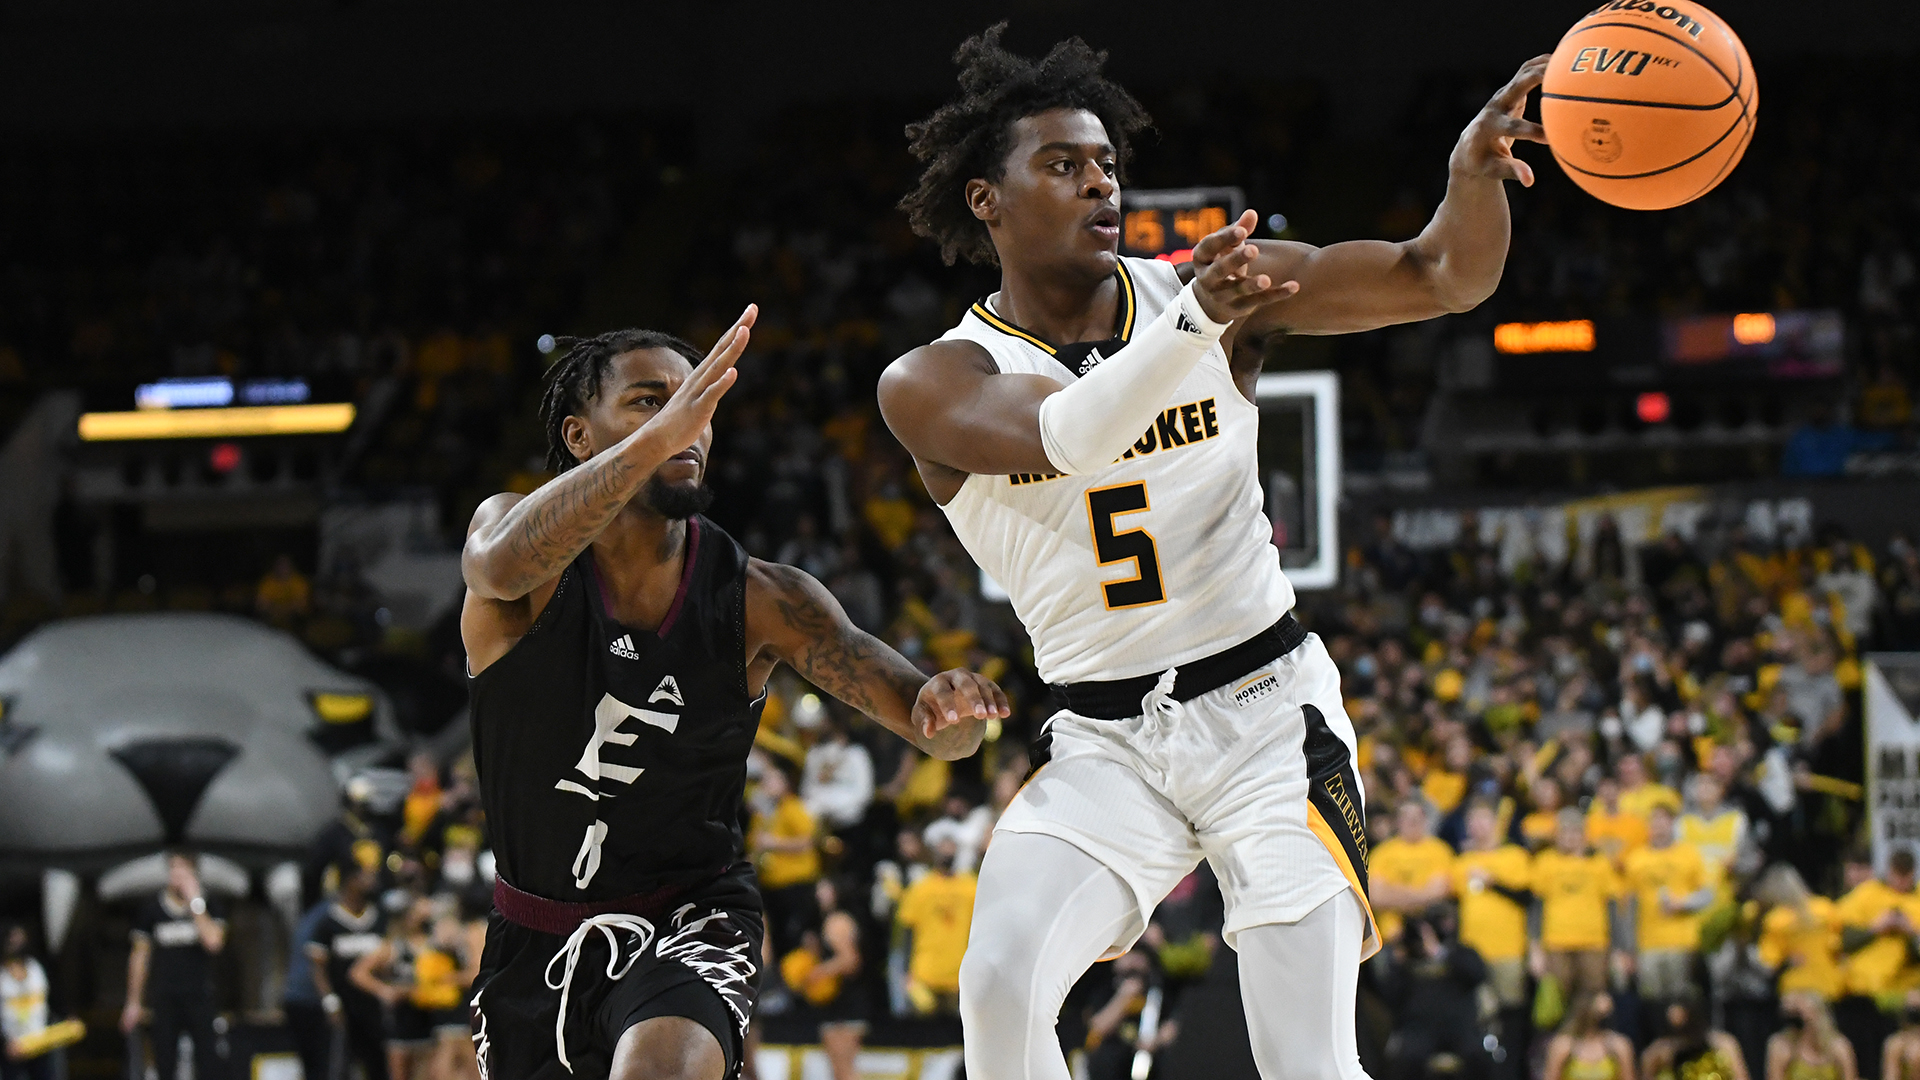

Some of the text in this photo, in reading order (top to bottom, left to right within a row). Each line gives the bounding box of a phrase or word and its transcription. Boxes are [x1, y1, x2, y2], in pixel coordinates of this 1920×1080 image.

[1578, 0, 1705, 41] ilson
[1570, 47, 1652, 76] EVO
[1084, 479, 1168, 611] 5
[609, 645, 640, 661] adidas
[1235, 675, 1277, 701] HORIZON
[1238, 683, 1280, 707] LEAGUE
